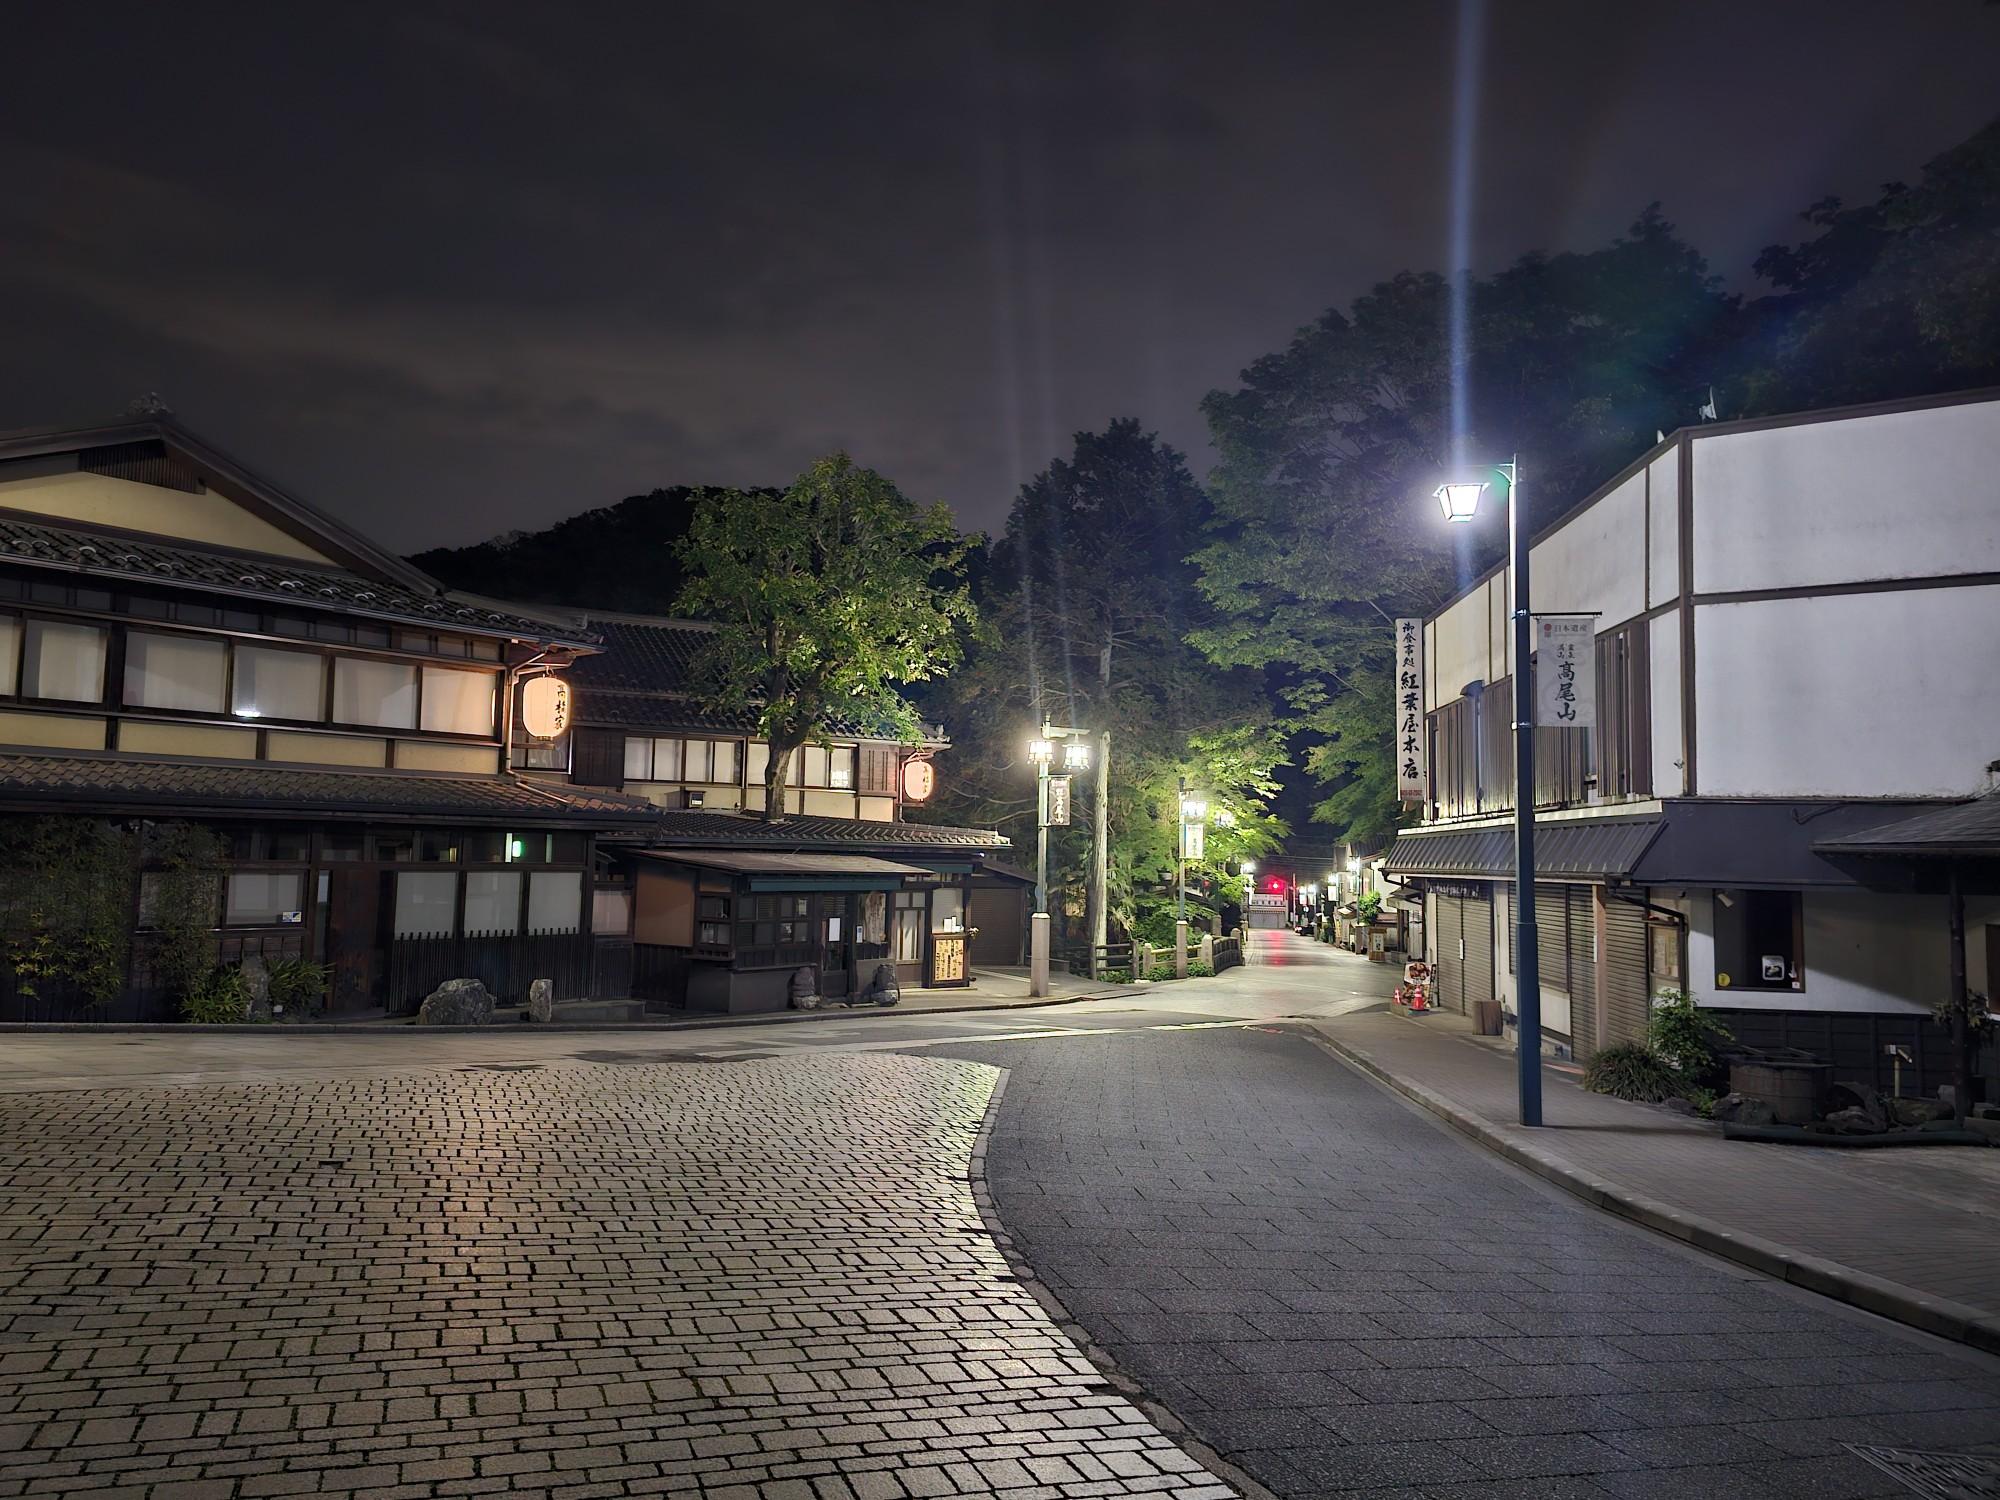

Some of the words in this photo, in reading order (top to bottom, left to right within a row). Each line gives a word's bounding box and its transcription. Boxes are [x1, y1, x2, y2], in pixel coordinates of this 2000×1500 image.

[1401, 671, 1420, 780] 紅葉屋本店
